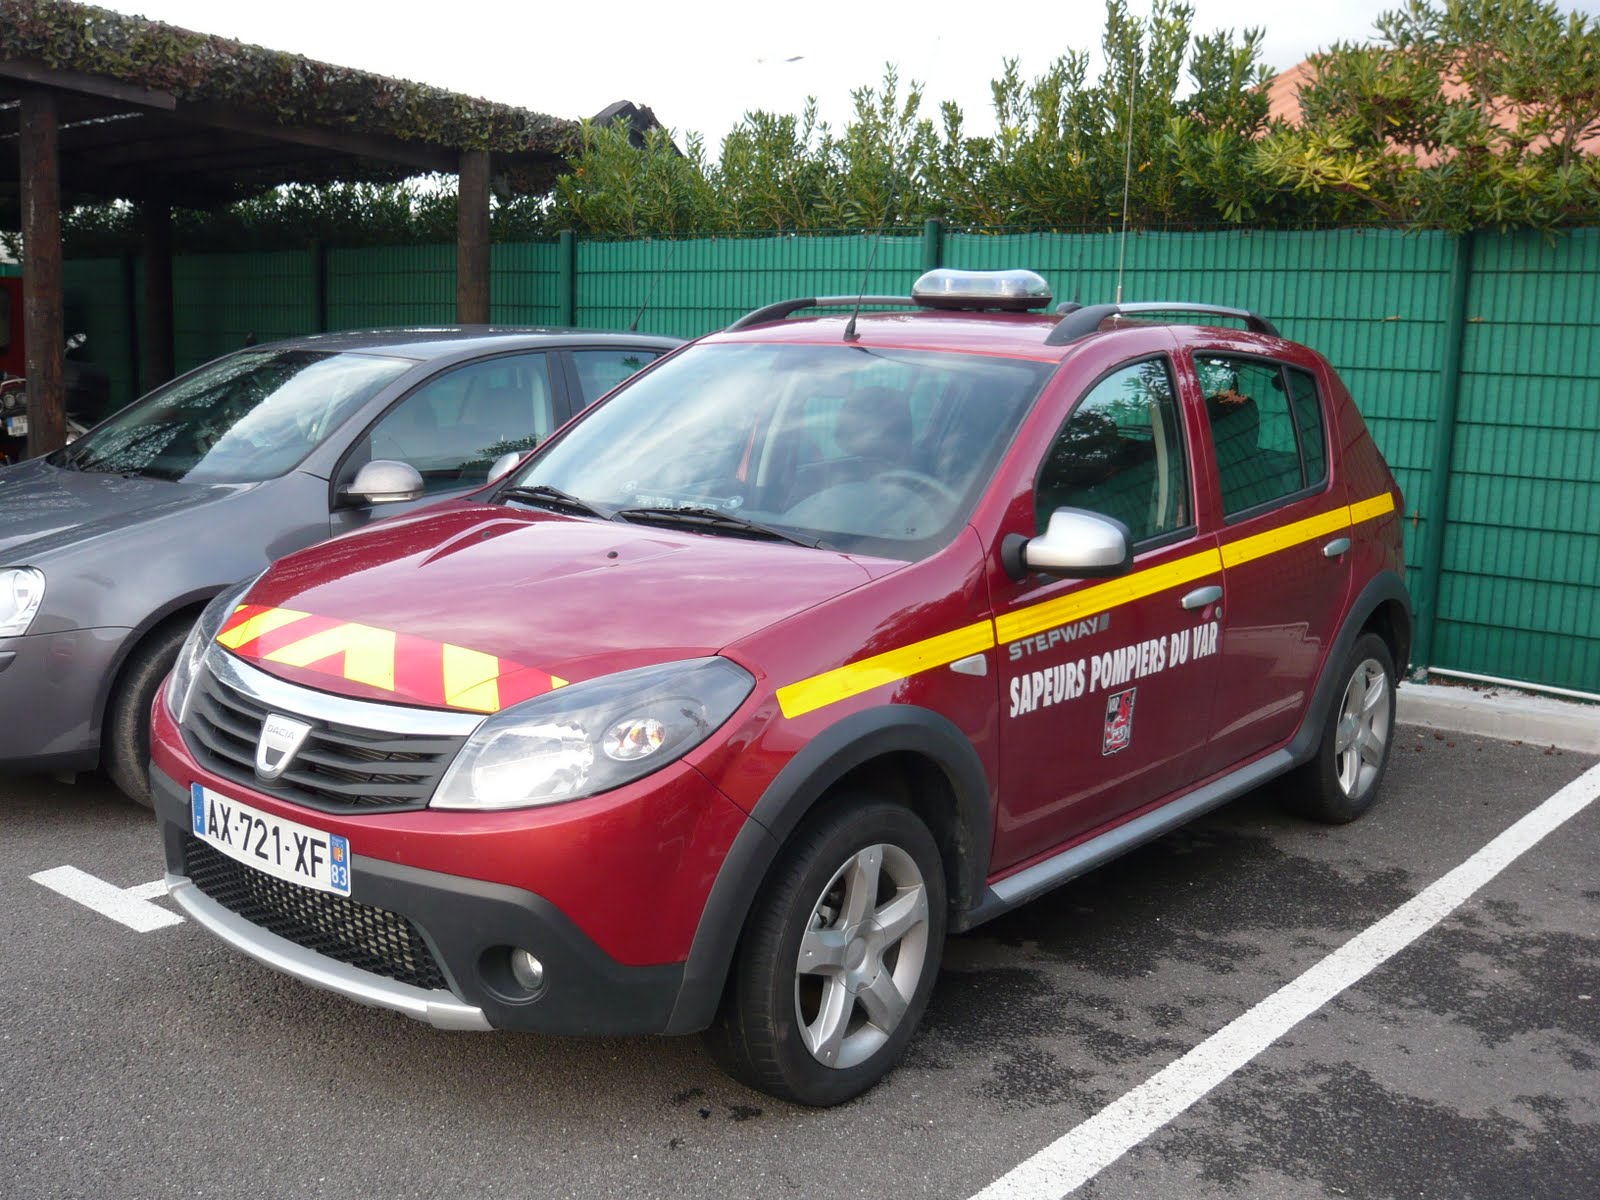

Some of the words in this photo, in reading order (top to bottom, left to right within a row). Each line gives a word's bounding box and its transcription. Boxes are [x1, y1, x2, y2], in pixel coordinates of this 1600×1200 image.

[1009, 617, 1099, 661] STEPWAY
[1010, 658, 1086, 718] SAPEURS
[1089, 636, 1167, 693] POMPIERS
[1169, 628, 1190, 668] DU
[1192, 621, 1219, 661] VAR
[266, 724, 295, 740] DACIA
[208, 799, 327, 878] AX-721-XF
[331, 863, 347, 887] 83
